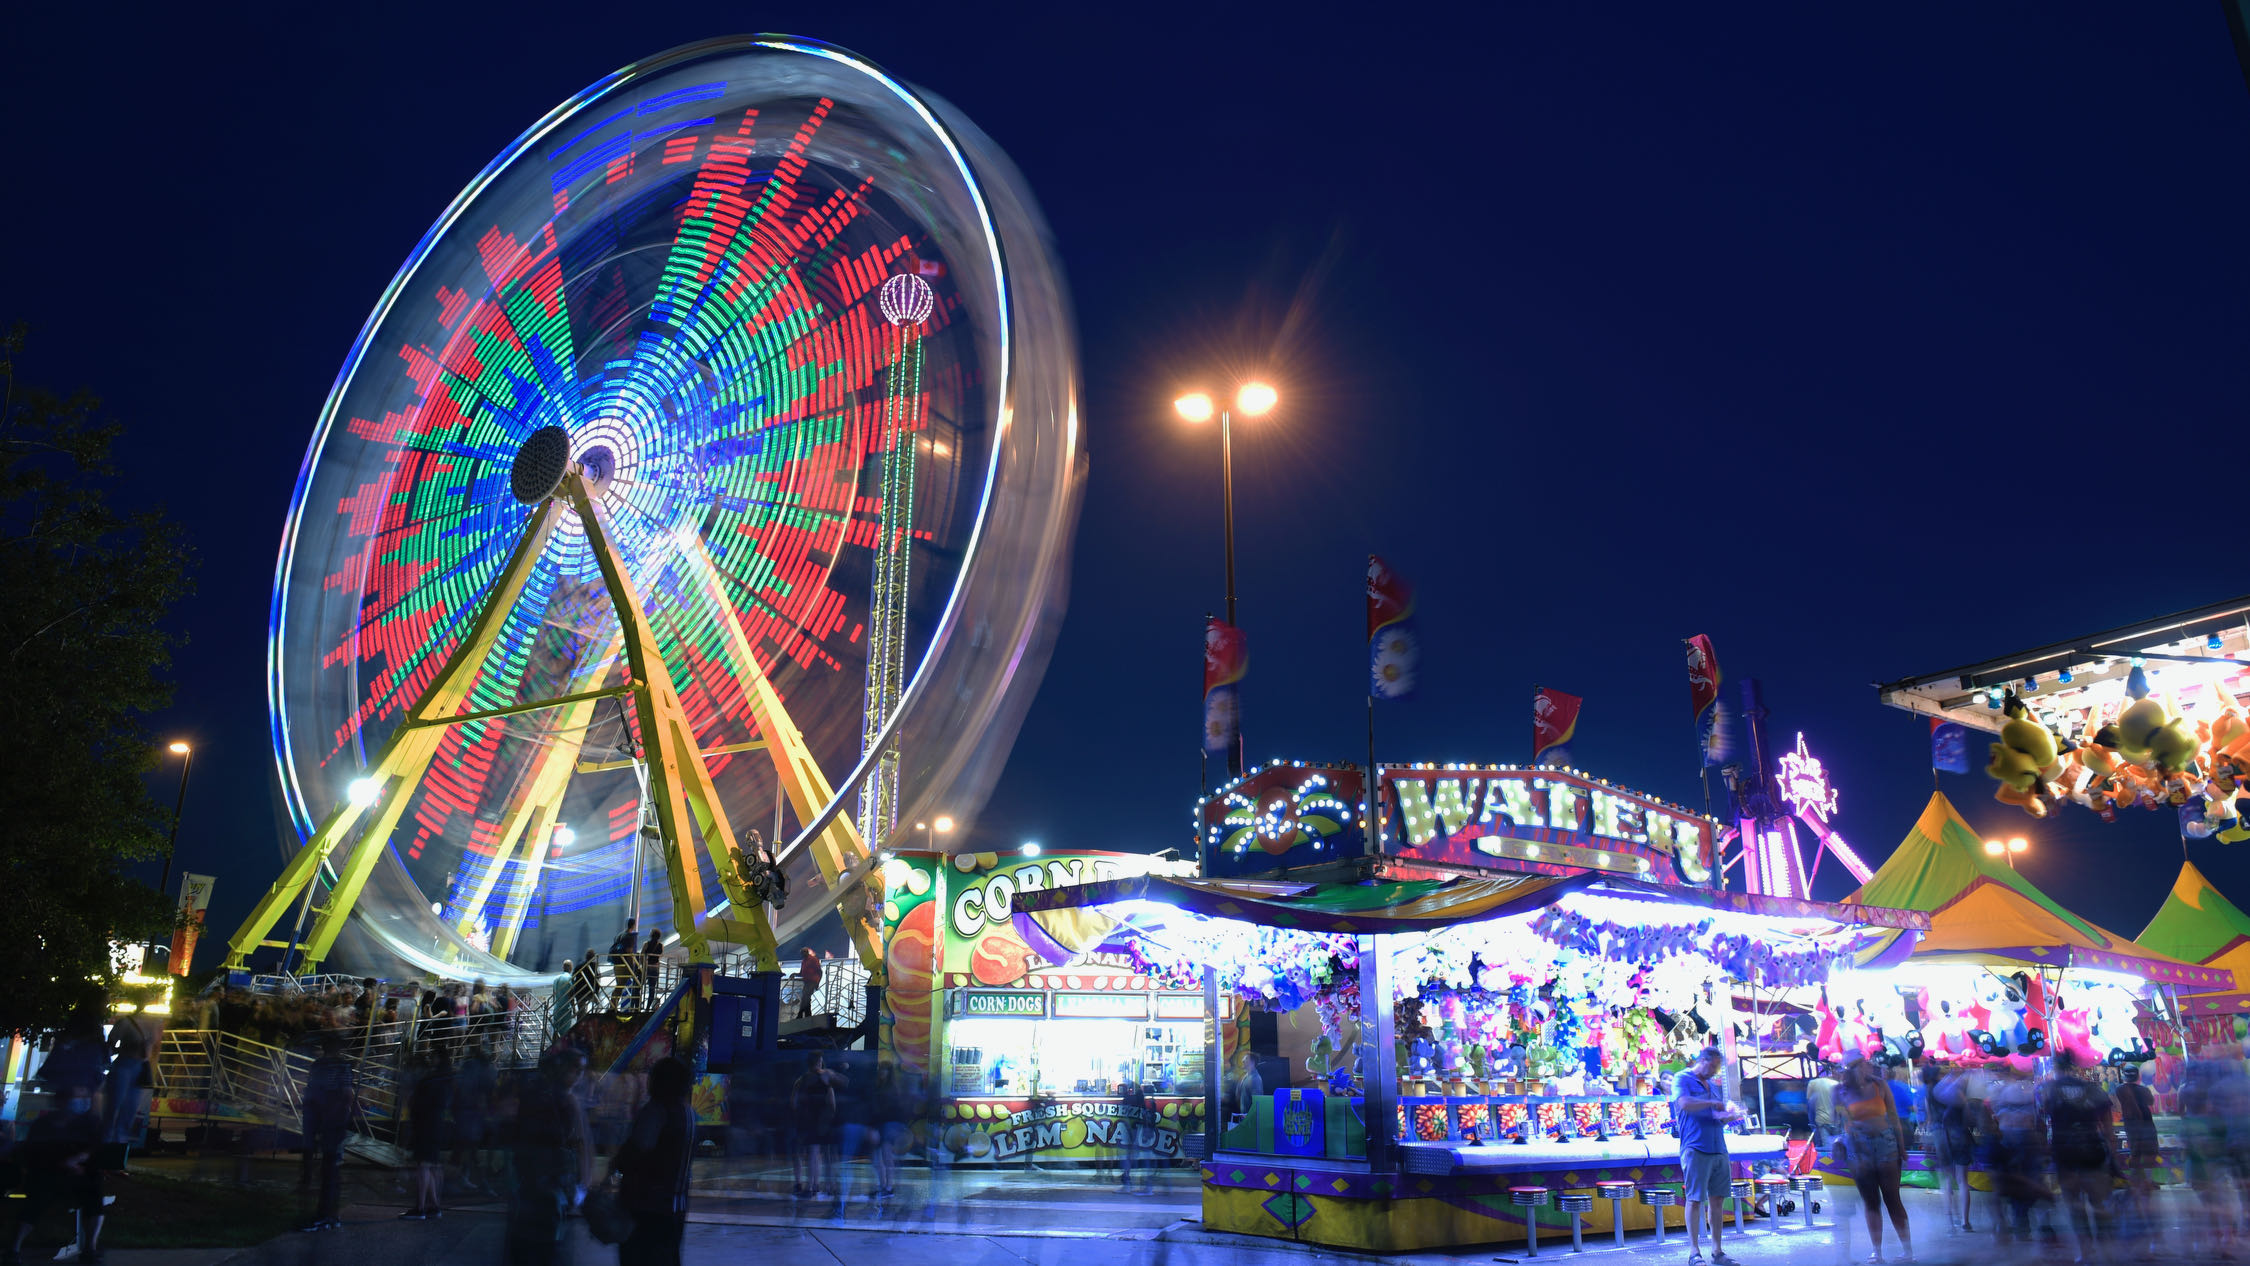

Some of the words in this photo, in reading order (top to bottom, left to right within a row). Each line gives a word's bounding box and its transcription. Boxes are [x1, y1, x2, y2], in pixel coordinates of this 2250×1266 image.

[1393, 778, 1711, 883] WATER
[954, 860, 1083, 936] CORN
[970, 996, 1005, 1012] CORN
[1007, 996, 1042, 1012] DOGS
[2188, 1015, 2237, 1045] WIN
[1011, 1104, 1069, 1126] FRESH
